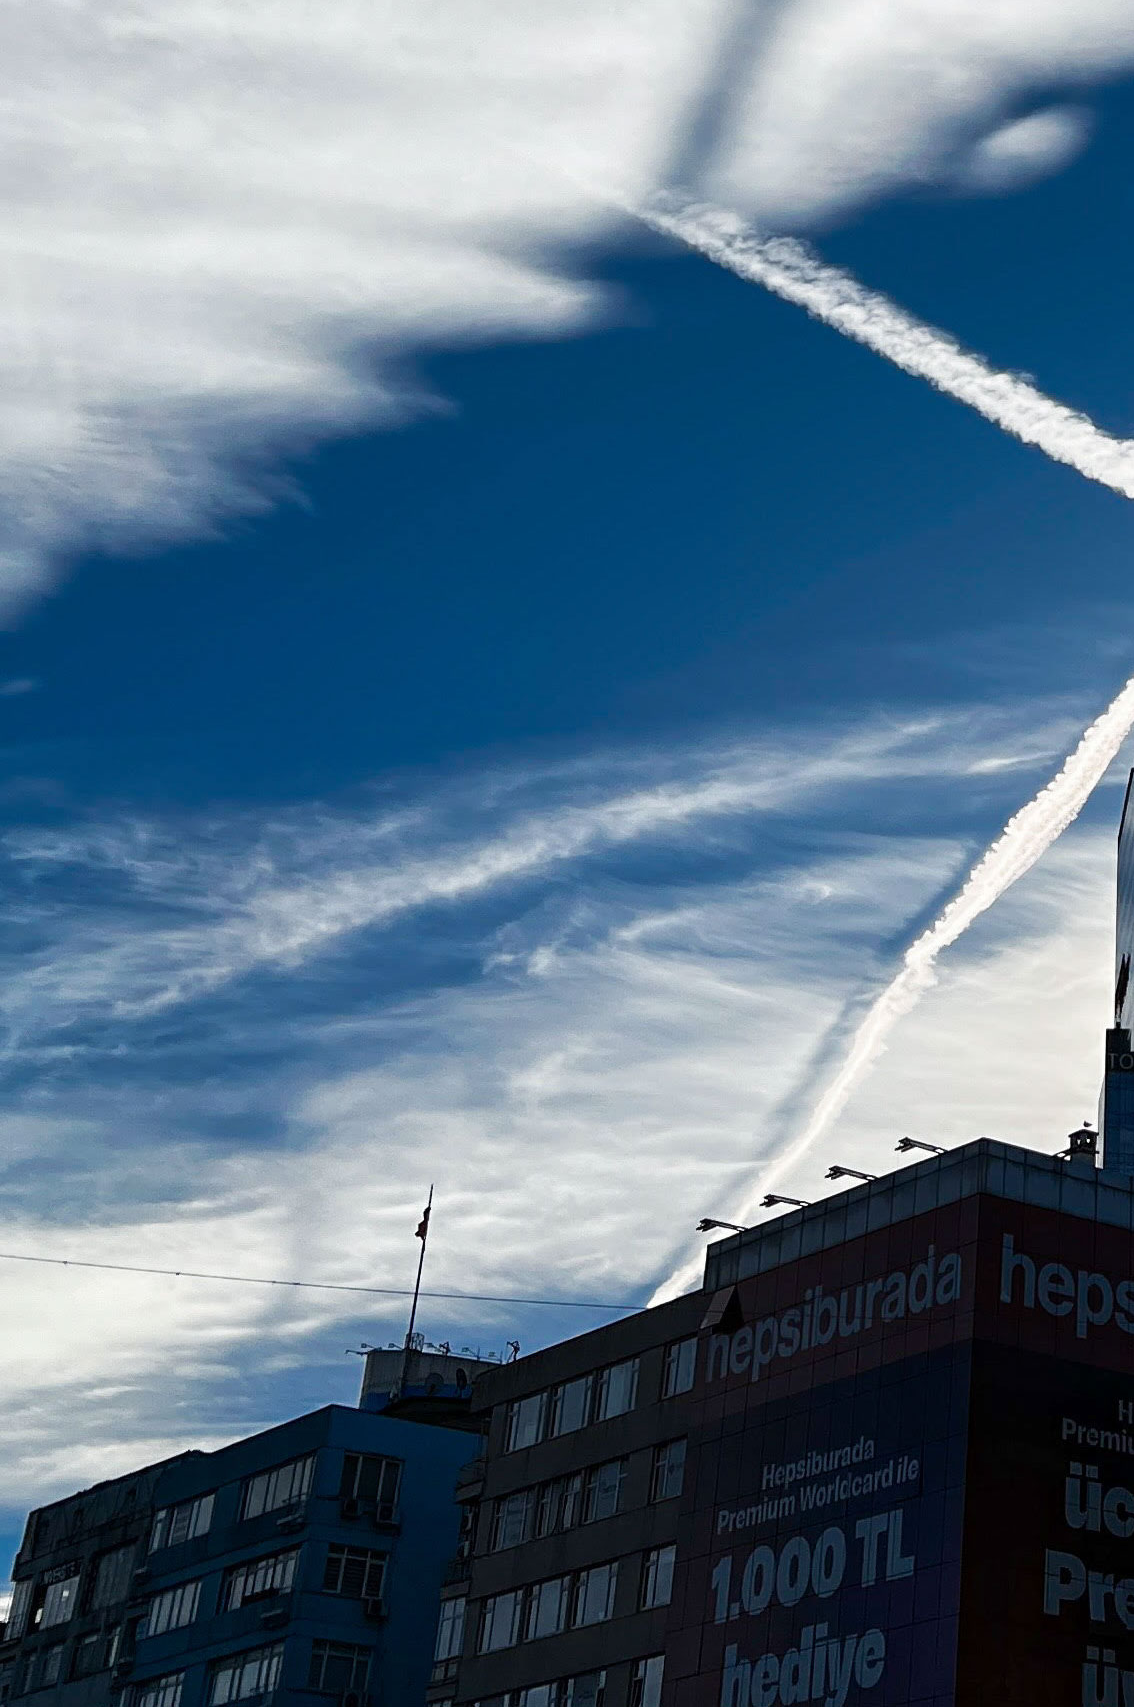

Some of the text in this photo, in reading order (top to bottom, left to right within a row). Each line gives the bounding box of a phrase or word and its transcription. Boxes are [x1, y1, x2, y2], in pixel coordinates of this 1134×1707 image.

[704, 1244, 962, 1383] hepsiburada
[717, 1455, 921, 1535] Premium Worldcard ile
[761, 1435, 875, 1491] Hepsiburada
[711, 1507, 915, 1625] 1.000 TL
[720, 1621, 887, 1707] hediye
